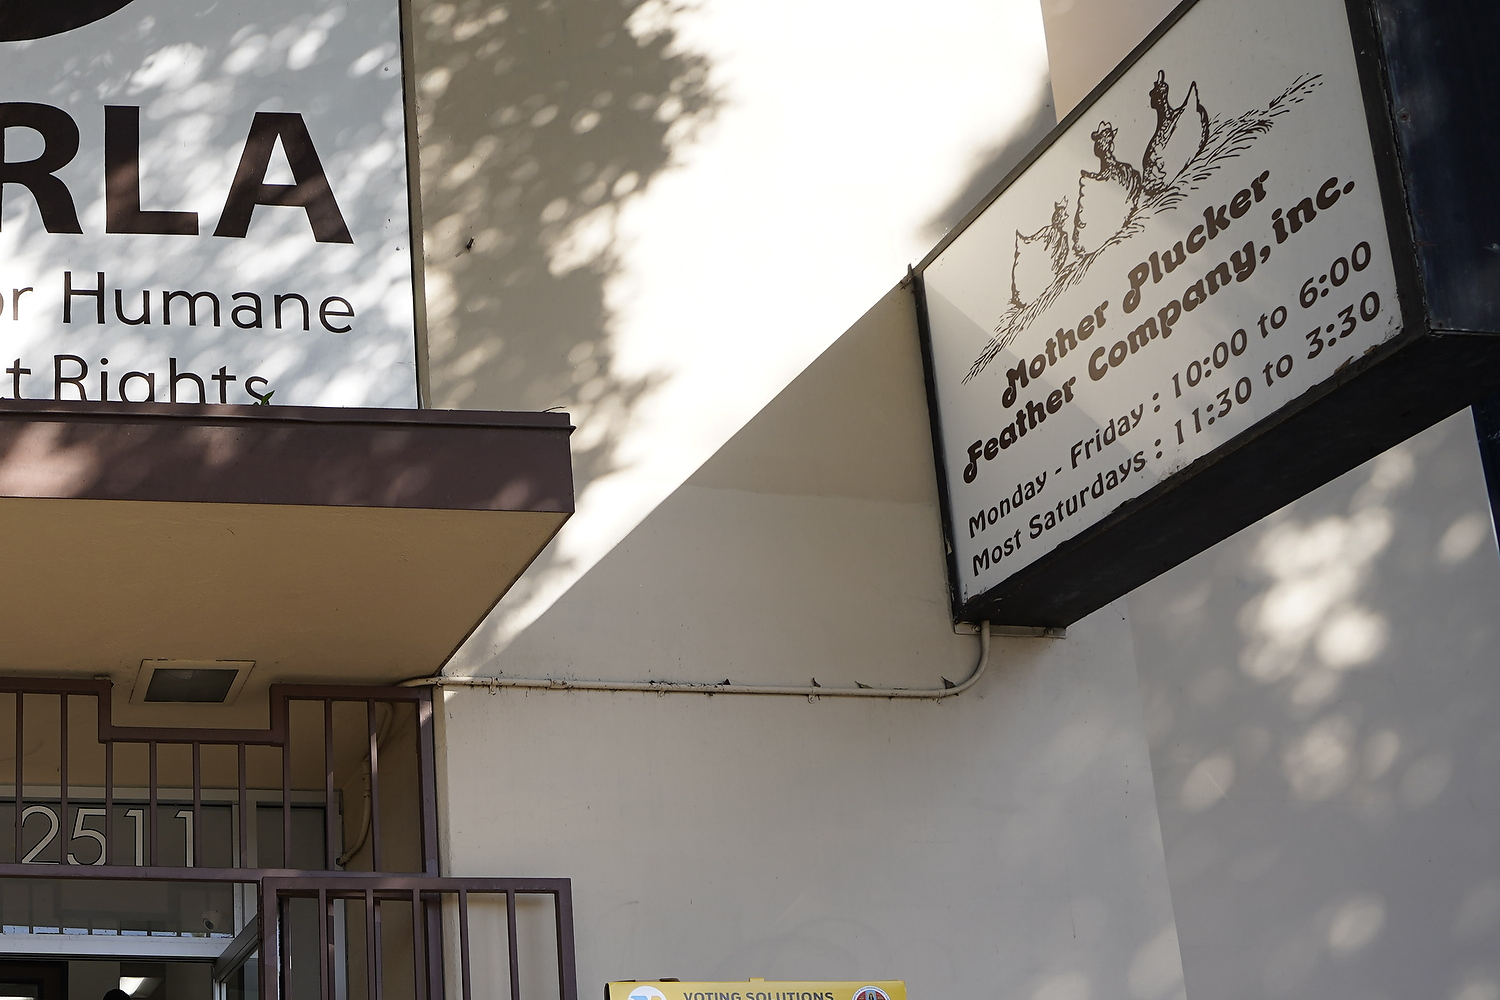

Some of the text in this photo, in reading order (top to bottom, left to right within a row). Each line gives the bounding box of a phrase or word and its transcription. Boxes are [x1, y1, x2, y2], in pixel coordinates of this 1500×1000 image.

[63, 271, 355, 335] Humane
[1001, 168, 1271, 409] Mother Plucker
[962, 377, 1077, 484] Feather
[968, 473, 1048, 538] Monday
[1069, 402, 1145, 470] Friday
[1171, 328, 1248, 399] 10:00
[1257, 305, 1288, 340] to
[1298, 241, 1372, 309] 6:00
[971, 529, 1023, 576] Most
[1028, 449, 1148, 537] Saturdays
[1174, 374, 1253, 445] 11:30
[1262, 353, 1294, 389] to
[1305, 290, 1381, 358] 3:30
[20, 804, 195, 867] 2511
